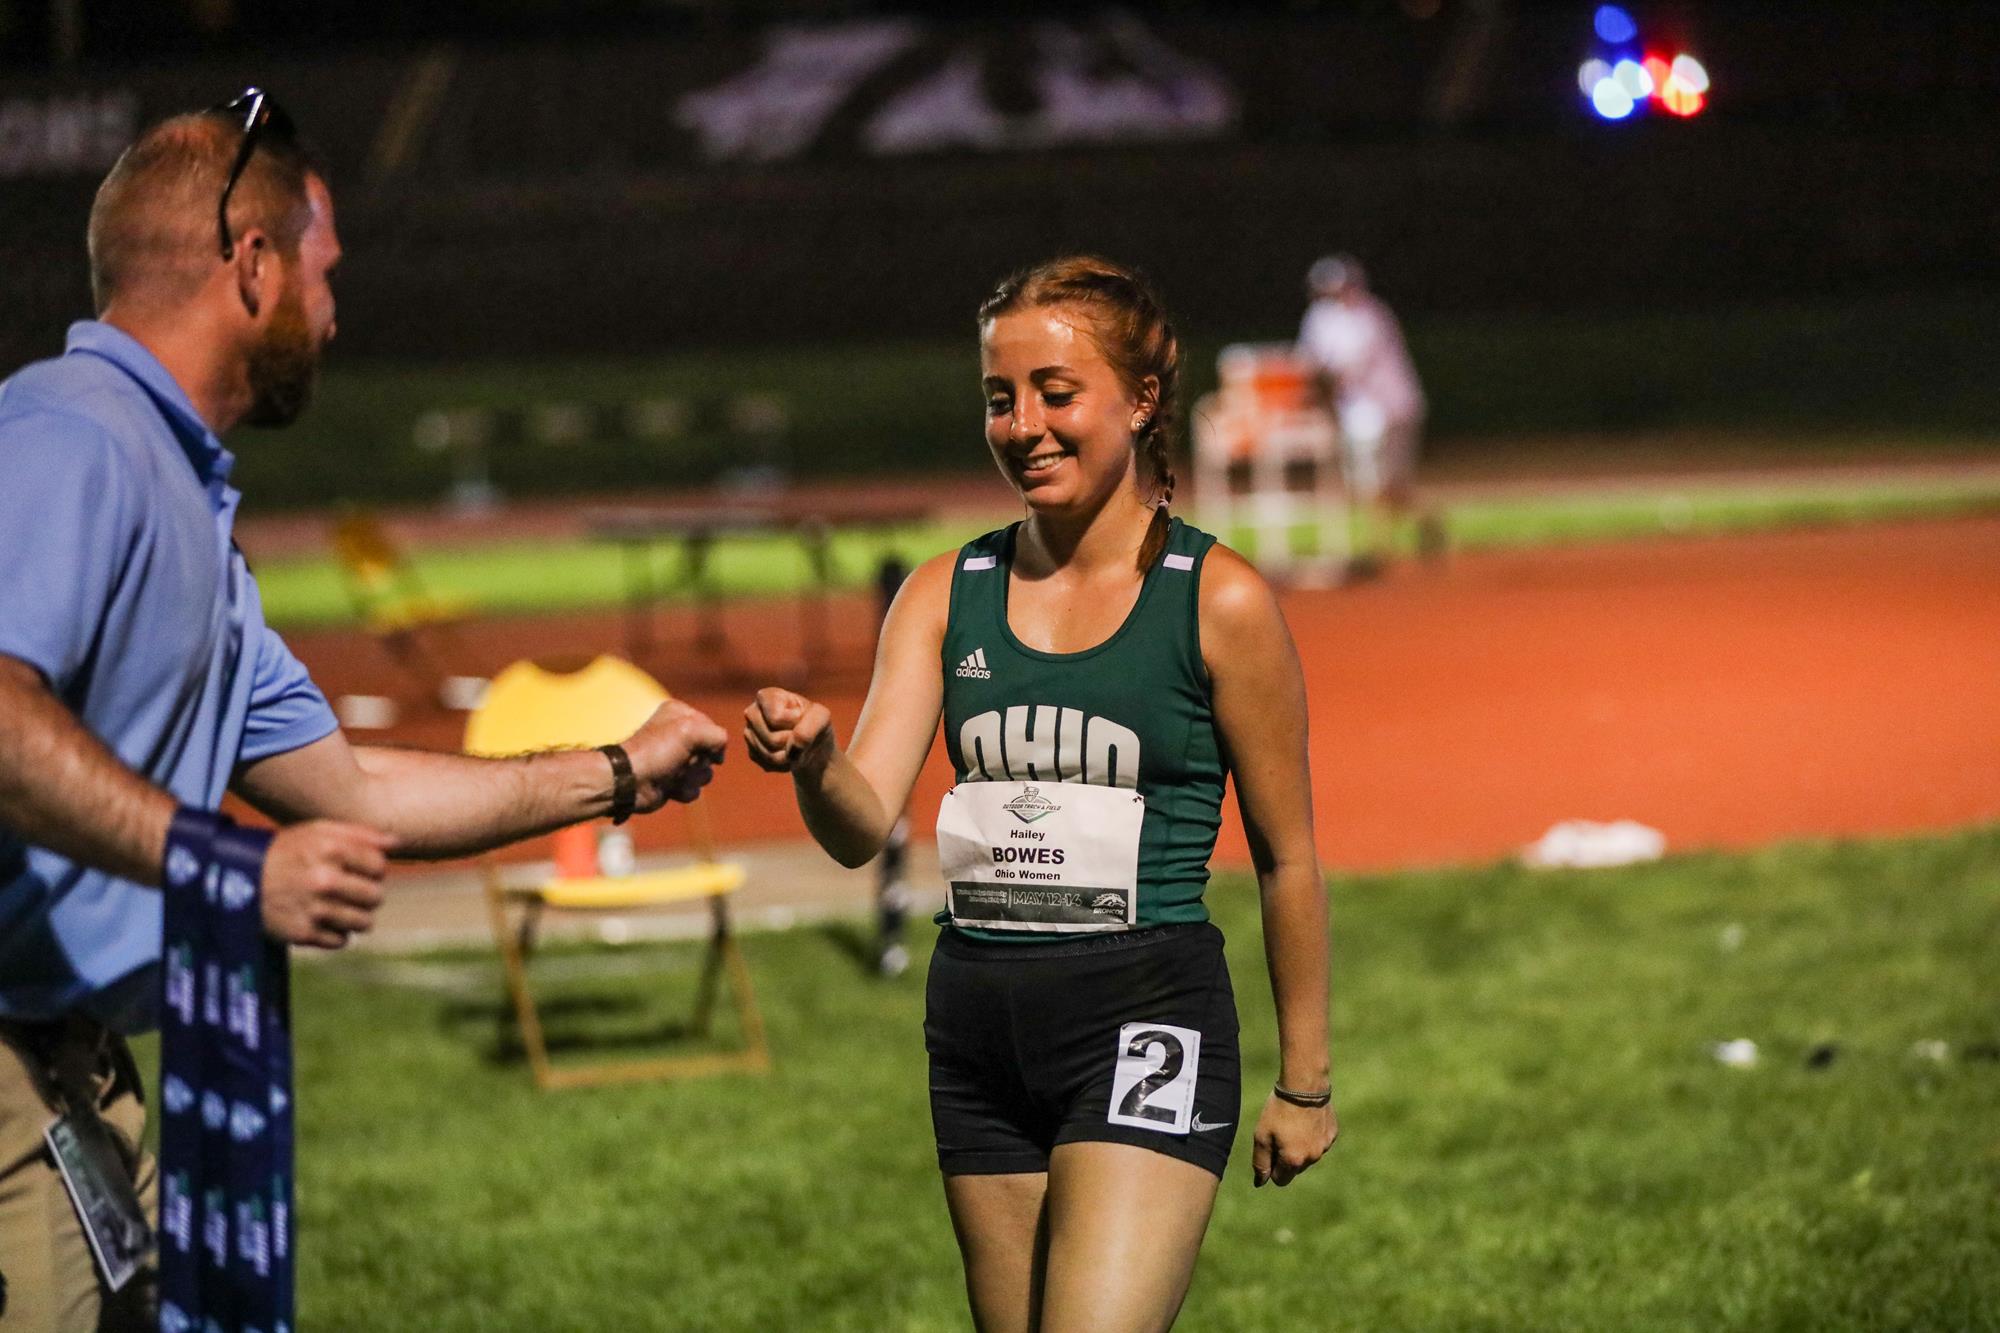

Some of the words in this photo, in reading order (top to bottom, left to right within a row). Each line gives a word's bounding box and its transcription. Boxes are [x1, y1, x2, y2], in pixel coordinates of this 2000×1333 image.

[956, 667, 991, 679] adidas
[960, 704, 1140, 790] OHIO
[1010, 829, 1045, 841] Hailey
[992, 847, 1065, 864] BOWES
[995, 869, 1015, 879] Ohio
[1019, 870, 1061, 880] Women
[1013, 891, 1045, 905] MAY
[1047, 892, 1081, 906] 12-14
[1118, 1030, 1184, 1125] 2
